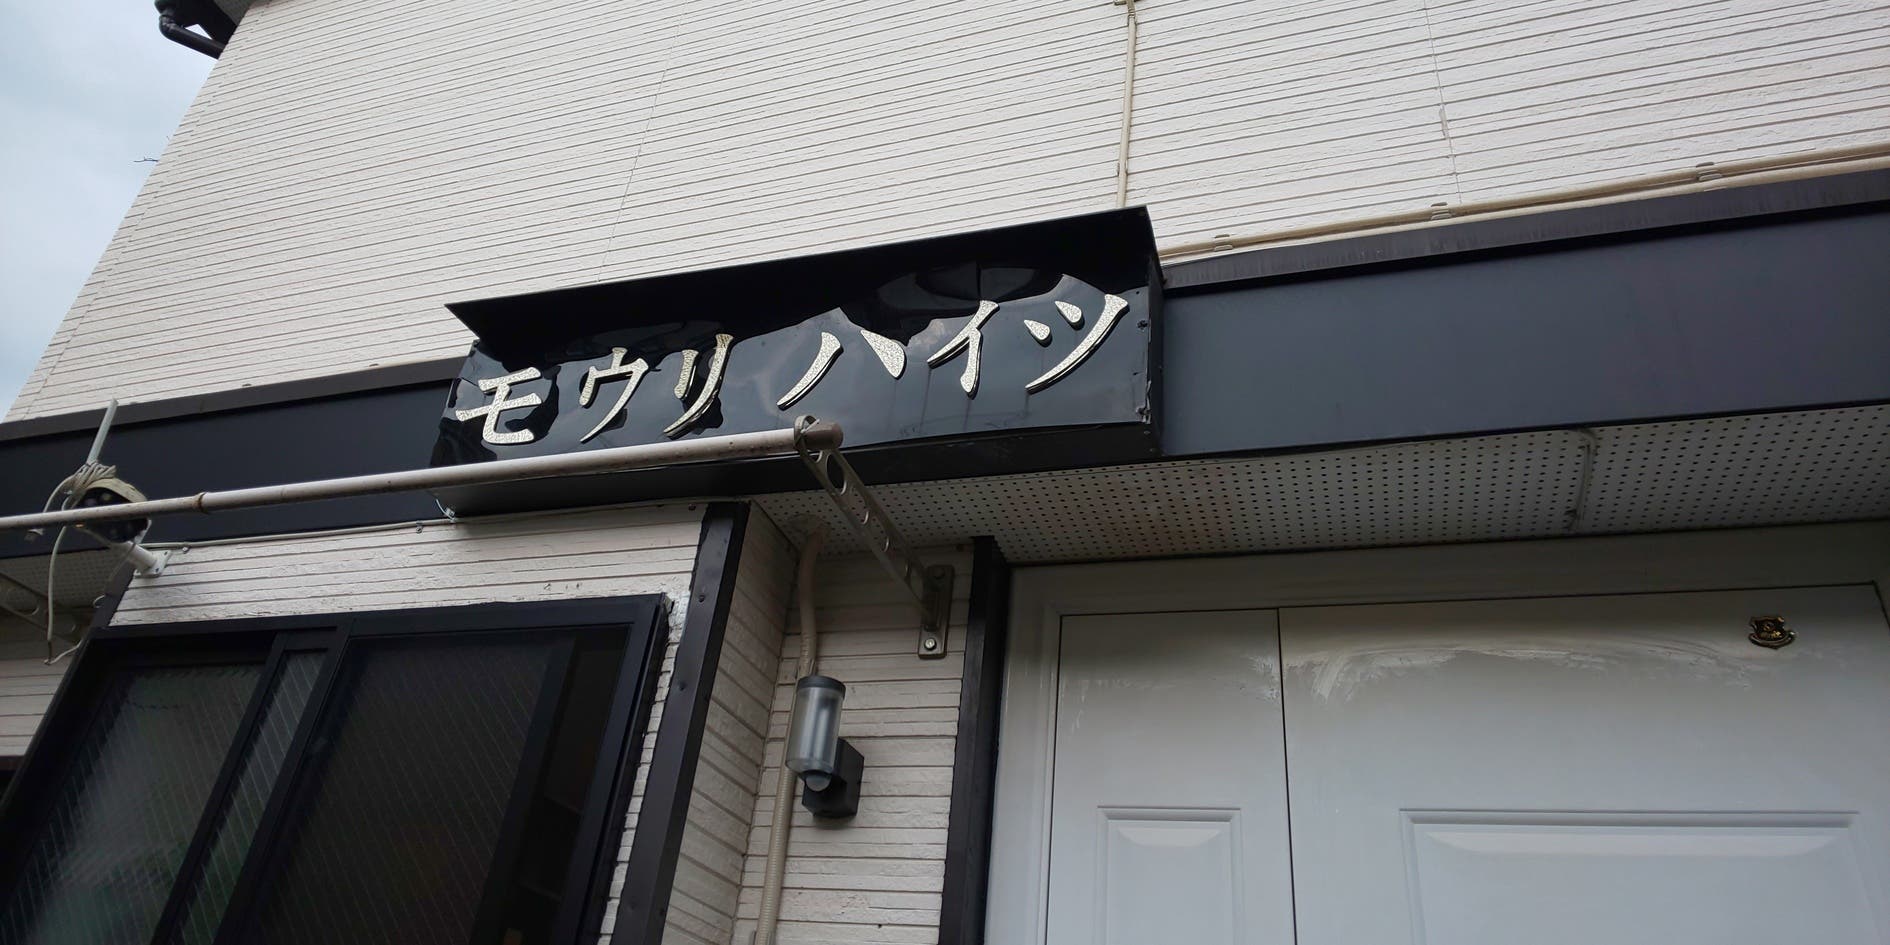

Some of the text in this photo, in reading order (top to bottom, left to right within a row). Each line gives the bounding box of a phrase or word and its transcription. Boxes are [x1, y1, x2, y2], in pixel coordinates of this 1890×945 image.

[456, 293, 1129, 443] モウリ ハイツ
